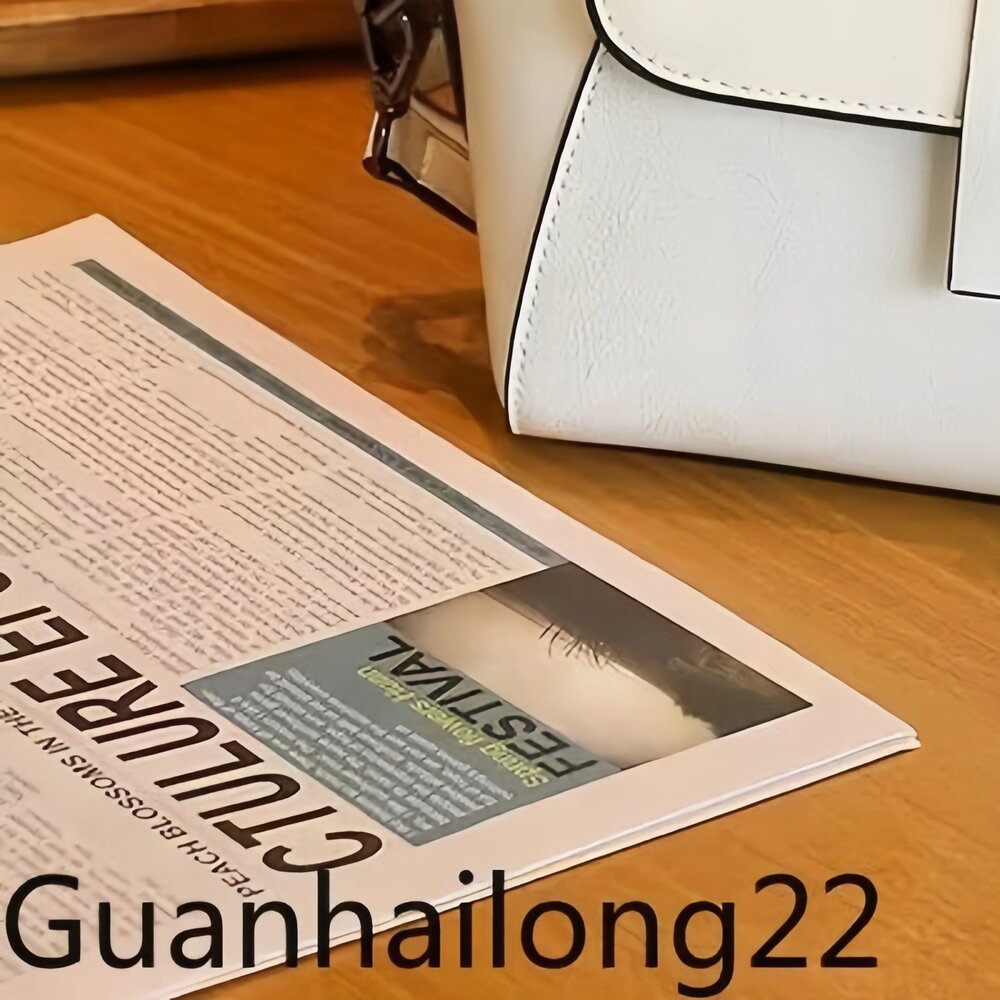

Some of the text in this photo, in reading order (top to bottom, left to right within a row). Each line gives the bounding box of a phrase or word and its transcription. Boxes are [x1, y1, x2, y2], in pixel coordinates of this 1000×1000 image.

[34, 736, 70, 754] IN
[367, 634, 598, 778] FESTIVAL
[10, 654, 382, 873] CTULURE
[61, 754, 187, 840] BLOSSOMS
[177, 840, 265, 897] PEACH
